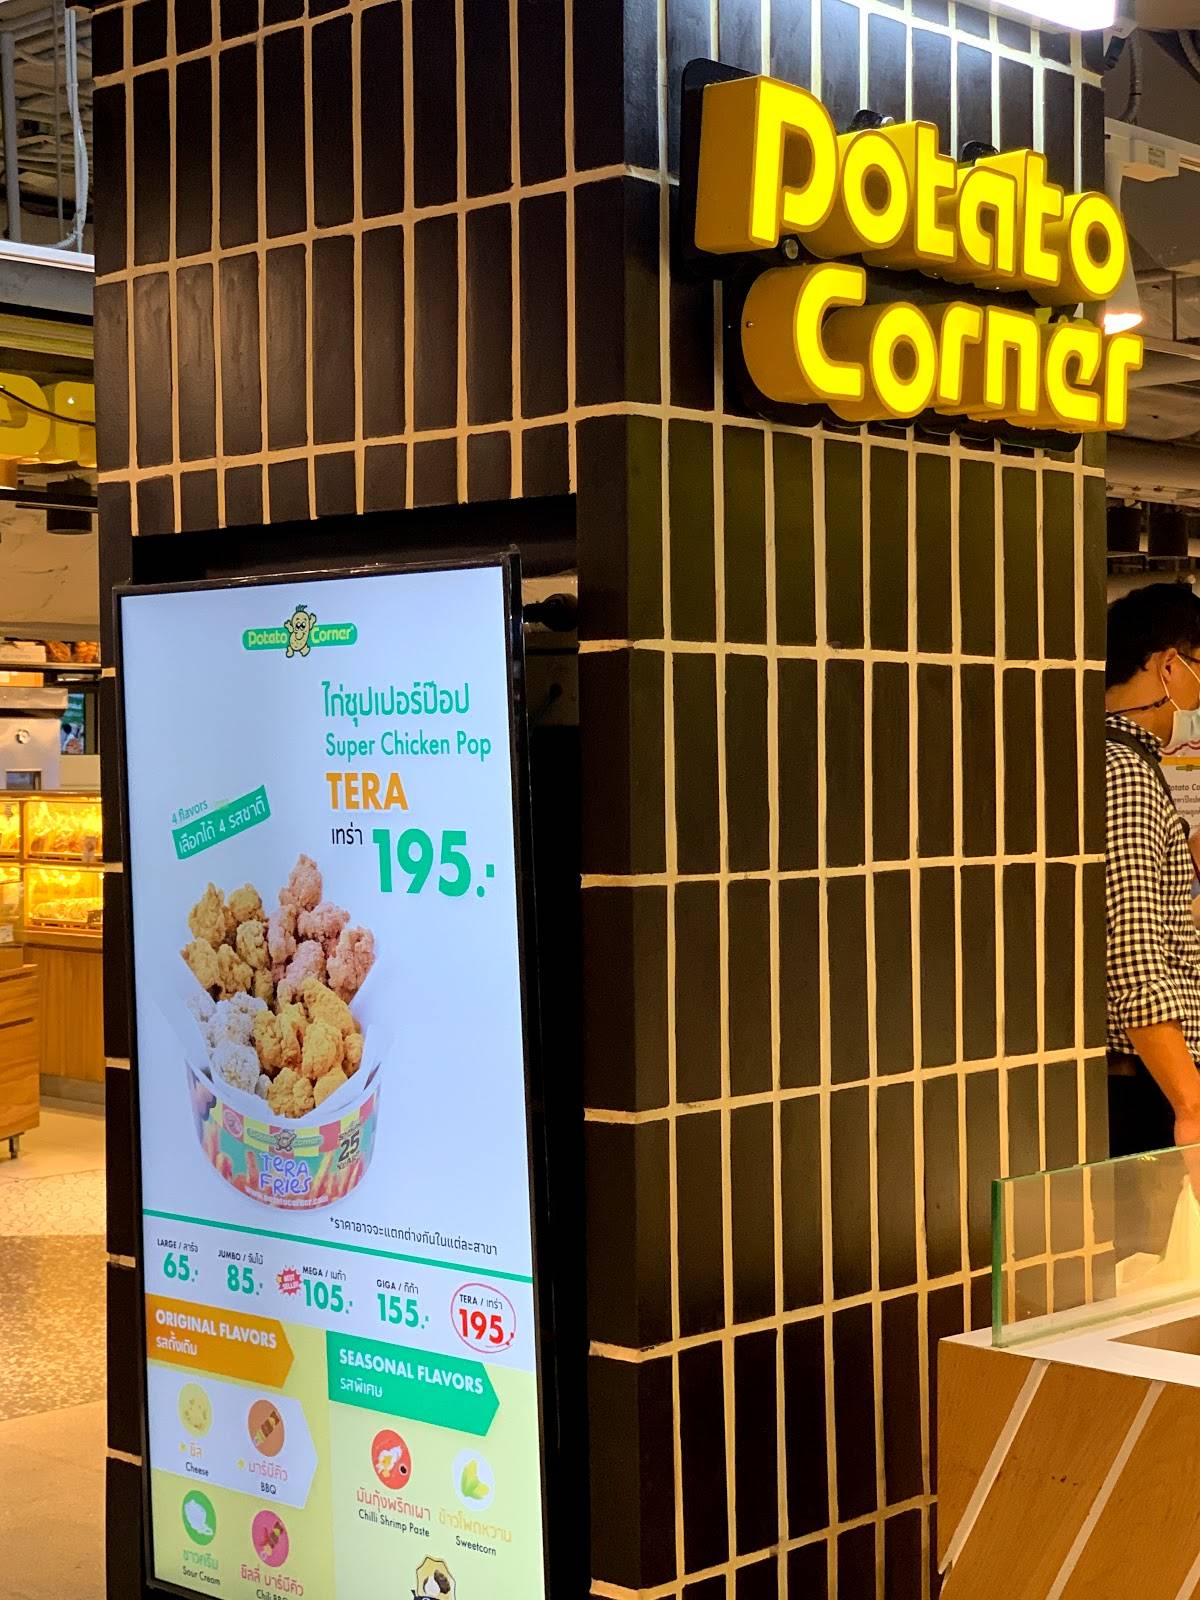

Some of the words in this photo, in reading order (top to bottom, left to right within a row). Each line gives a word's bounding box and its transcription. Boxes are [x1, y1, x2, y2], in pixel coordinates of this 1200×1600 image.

[750, 76, 1128, 300] Potato
[795, 263, 1143, 430] Corner
[248, 630, 288, 648] Potato
[310, 625, 352, 644] Corner
[326, 732, 376, 763] Super
[381, 729, 450, 756] Chicken
[457, 730, 492, 762] Pop
[326, 772, 409, 810] TERA
[171, 812, 178, 824] 4
[178, 800, 208, 820] flavors
[179, 821, 216, 854] เลือกได้
[219, 819, 226, 832] 4
[228, 795, 266, 829] รสชาติ
[331, 821, 363, 845] เทร่า
[157, 1238, 177, 1249] LARGE
[218, 1250, 241, 1261] JUMBO
[302, 1266, 323, 1277] MEGA
[376, 1279, 397, 1290] GIGA
[459, 1294, 478, 1305] TERA
[155, 1309, 217, 1336] ORIGINAL
[219, 1323, 277, 1349] FLAVORS
[339, 1348, 415, 1379] SEASONAL
[417, 1365, 484, 1394] FLAVORS
[185, 1461, 209, 1476] Cheese
[260, 1482, 277, 1494] BBQ
[358, 1508, 378, 1523] Chilli
[380, 1514, 407, 1533] Shrimp
[409, 1523, 430, 1537] Paste
[455, 1535, 497, 1556] Sweetcorn
[182, 1565, 198, 1578] Sour
[199, 1571, 221, 1585] Cream
